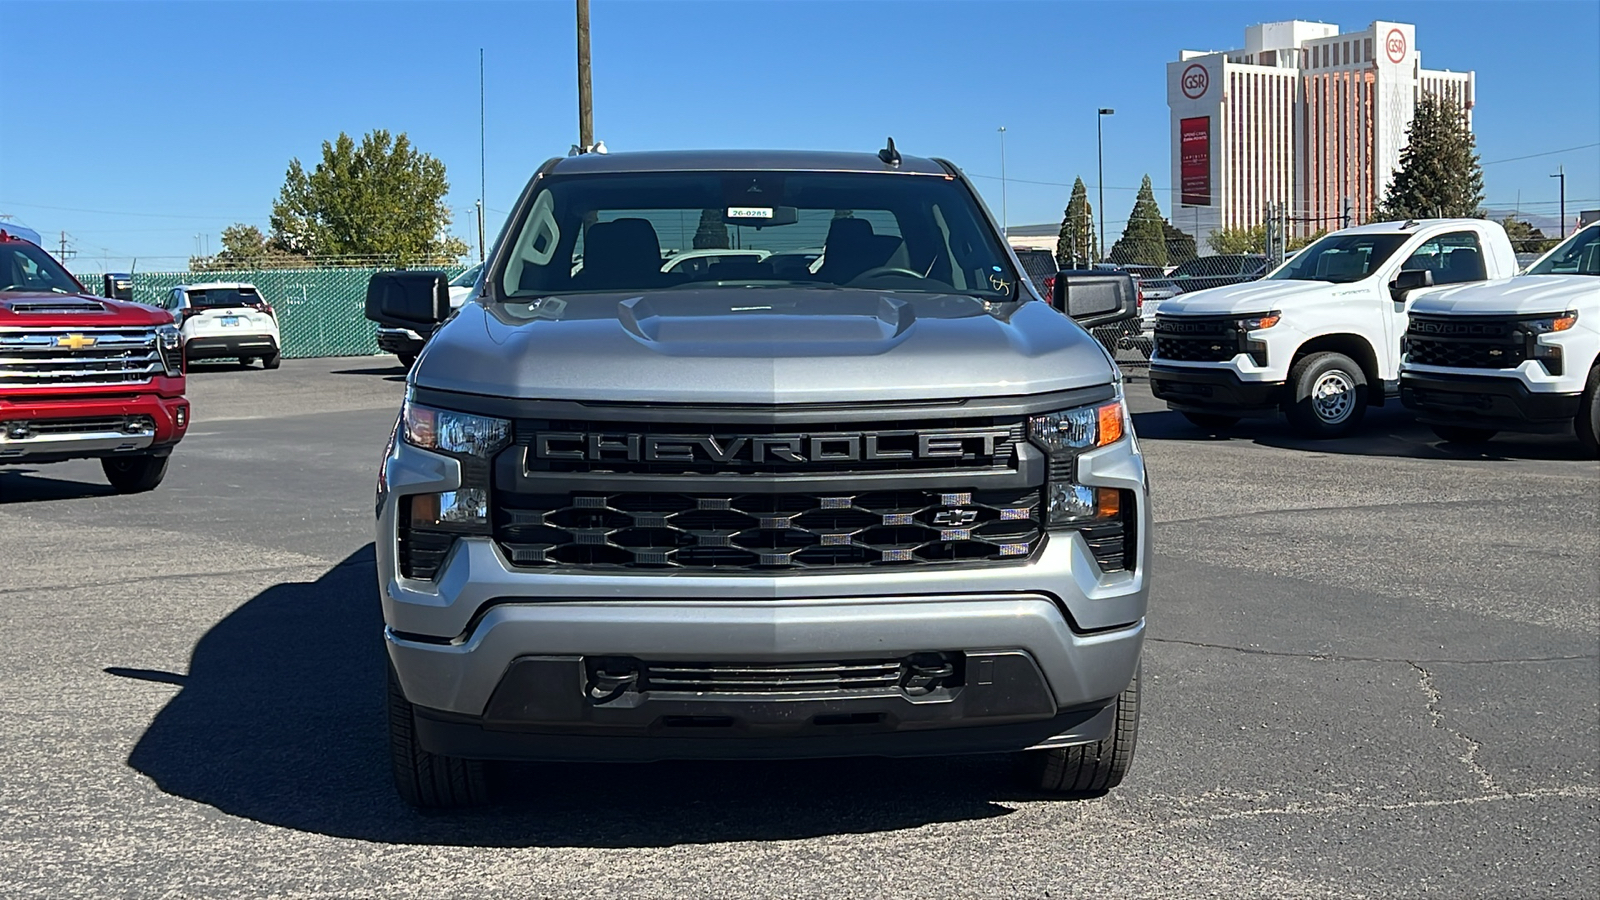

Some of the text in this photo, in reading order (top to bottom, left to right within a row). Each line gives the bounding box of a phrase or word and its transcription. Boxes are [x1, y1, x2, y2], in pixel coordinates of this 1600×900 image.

[1388, 38, 1403, 53] GSR
[1184, 74, 1205, 90] GSR
[535, 430, 1011, 463] CHEVROLET
